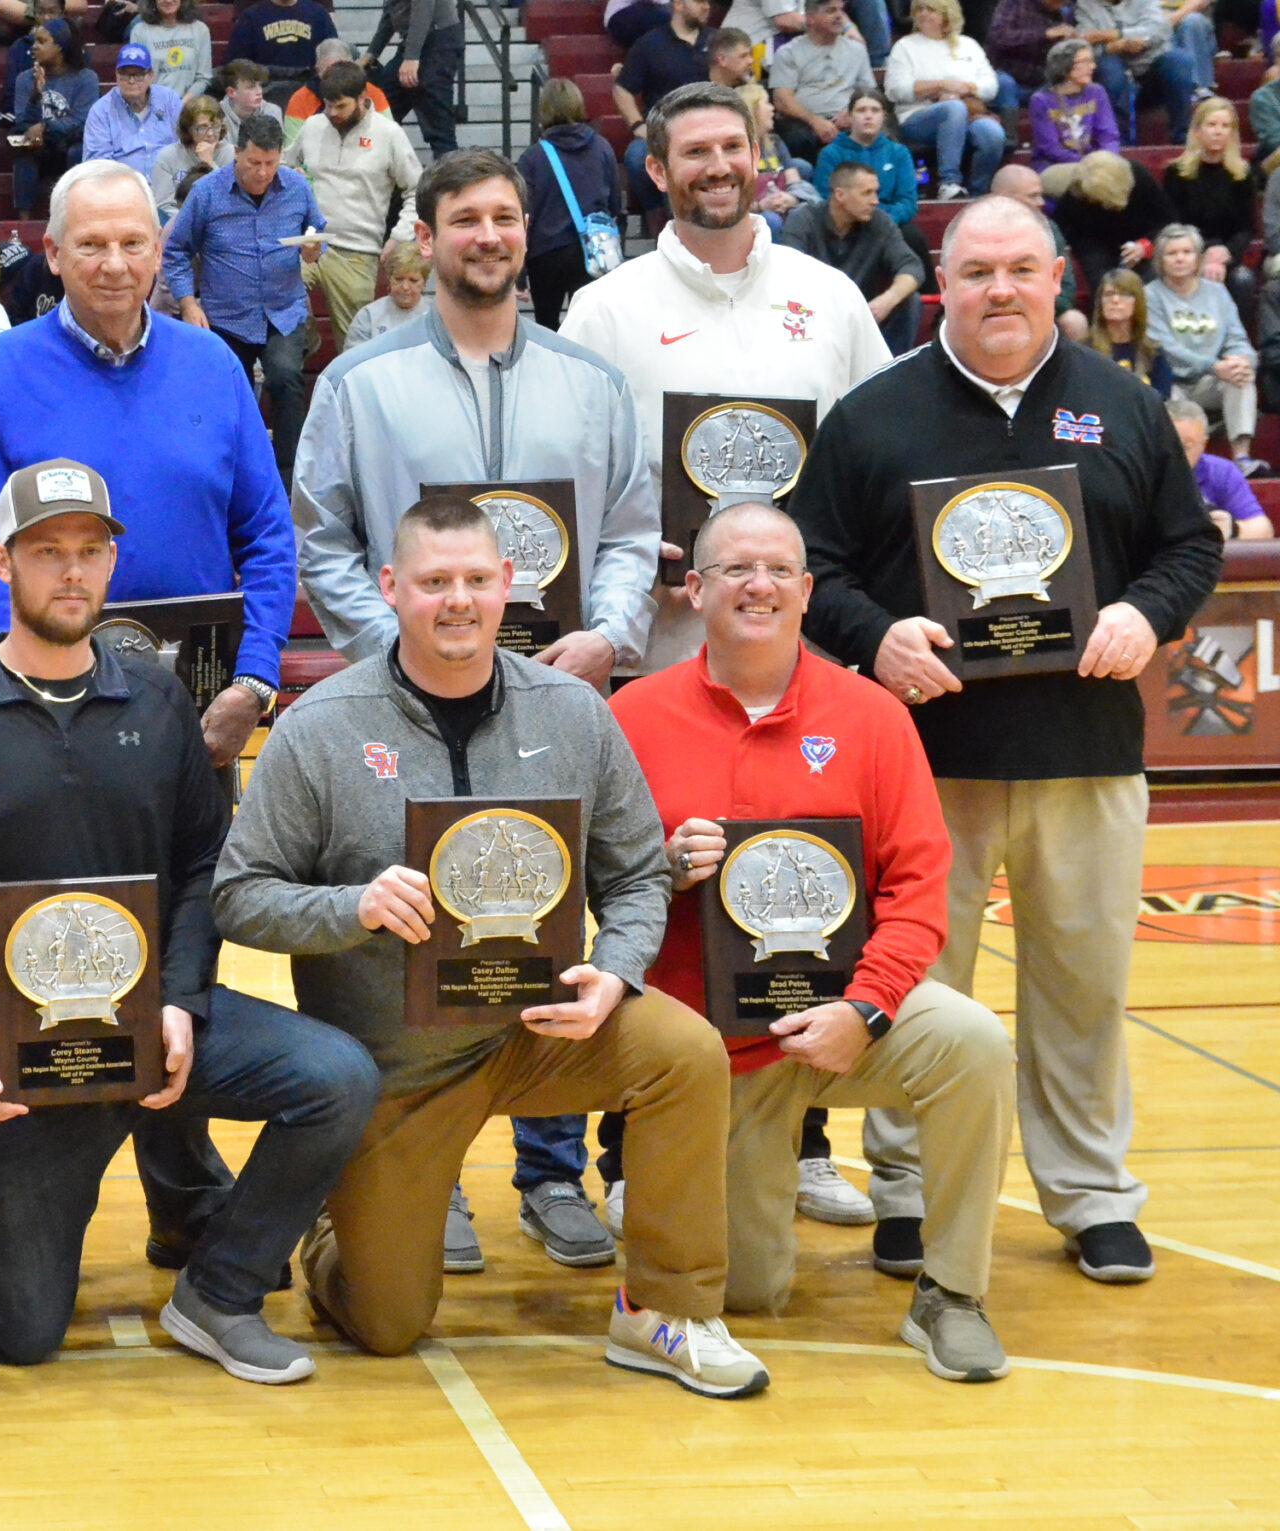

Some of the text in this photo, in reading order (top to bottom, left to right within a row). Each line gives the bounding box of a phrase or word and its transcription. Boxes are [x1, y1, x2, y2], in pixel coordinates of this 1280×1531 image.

[988, 623, 1018, 631] Spencer
[363, 743, 399, 778] SW
[472, 967, 493, 975] Casey
[789, 980, 811, 988] Petrey
[74, 1047, 101, 1055] Stearns
